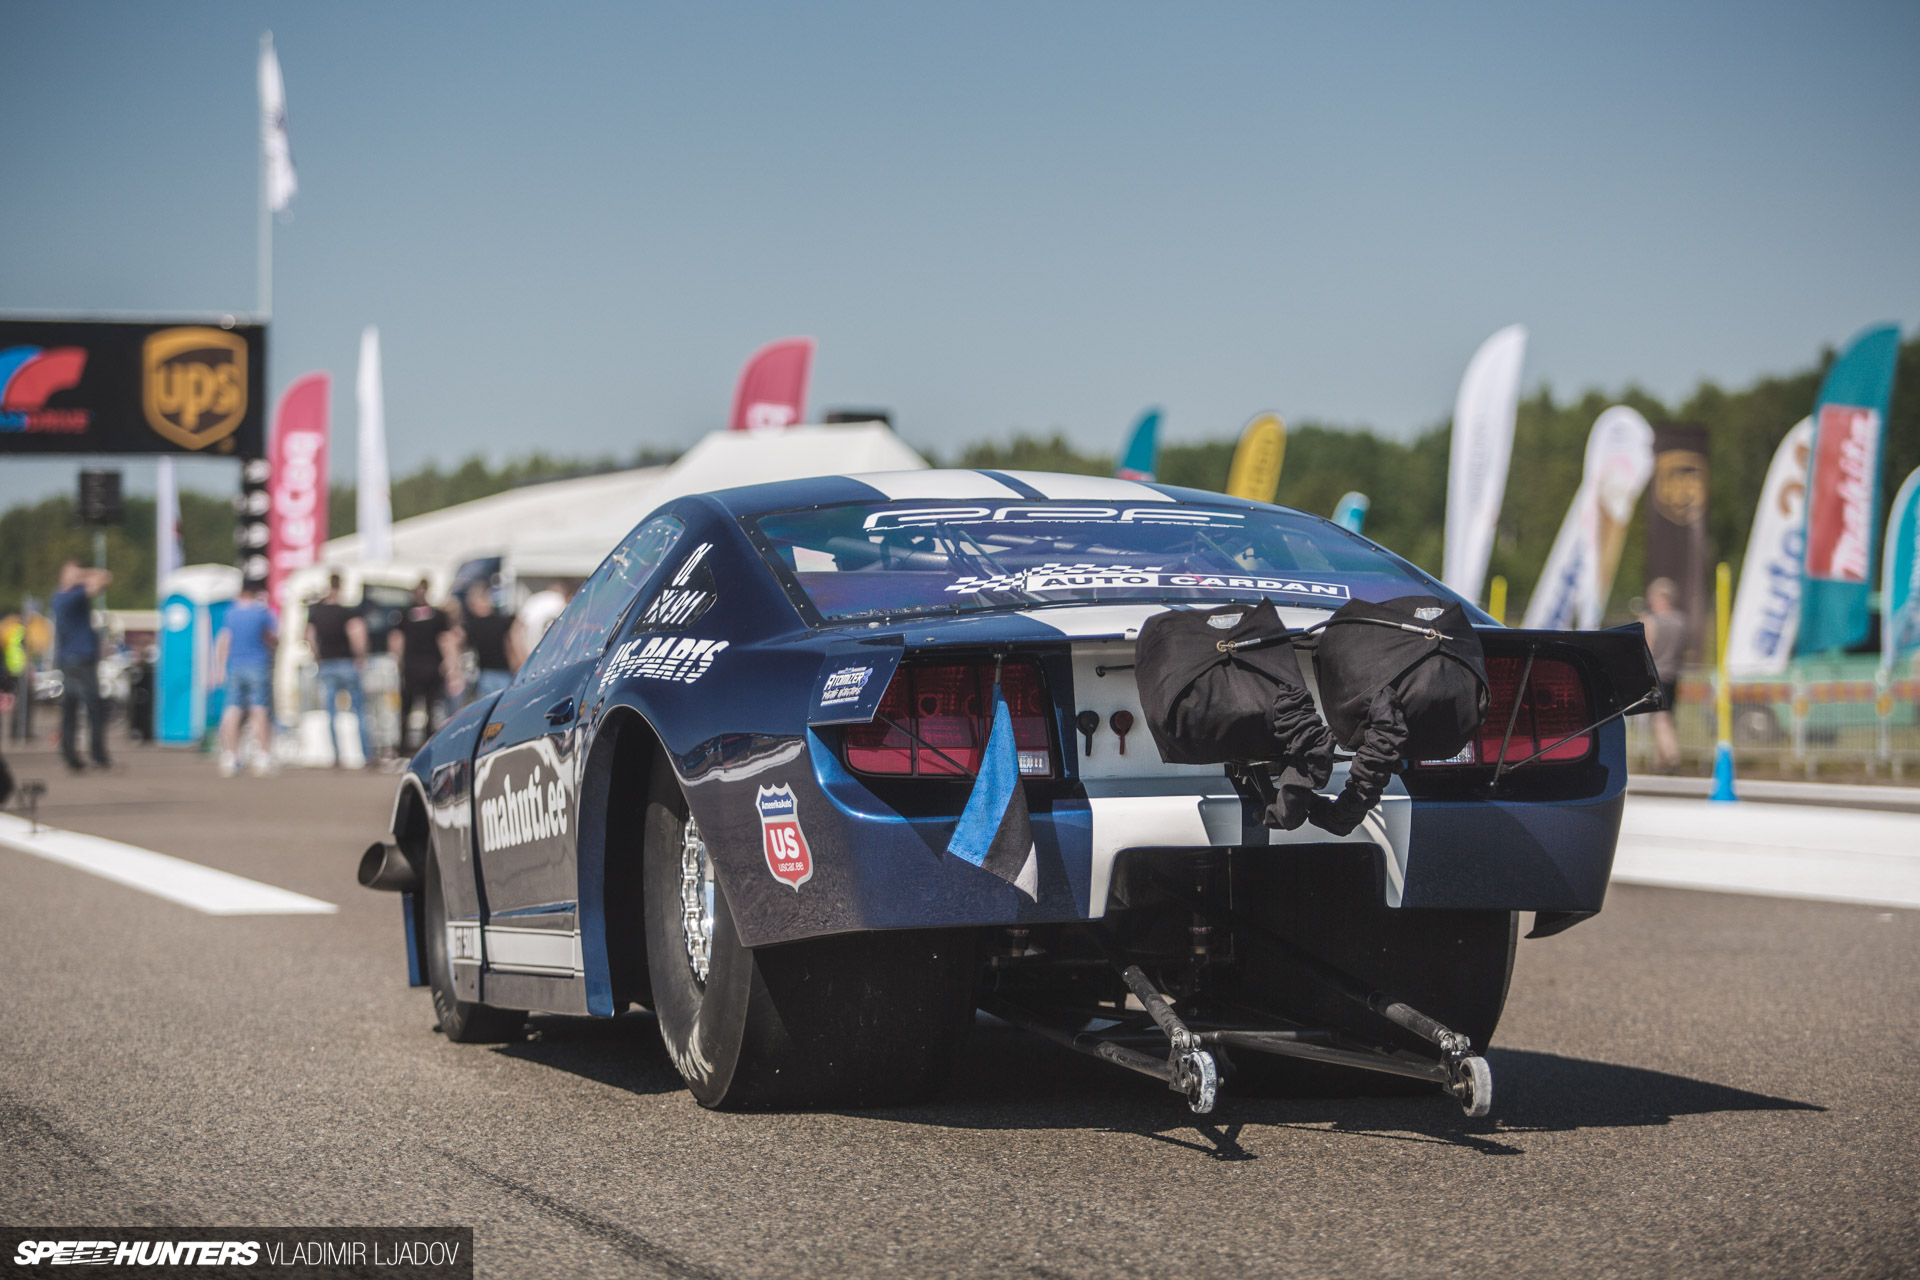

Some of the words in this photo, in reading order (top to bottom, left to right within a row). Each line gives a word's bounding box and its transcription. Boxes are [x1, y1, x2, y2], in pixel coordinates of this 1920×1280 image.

[1041, 576, 1149, 587] AUTO
[1170, 576, 1338, 595] CARDAN
[481, 765, 567, 853] mahuti.ee
[769, 827, 800, 860] US
[778, 862, 805, 873] uscar.ee
